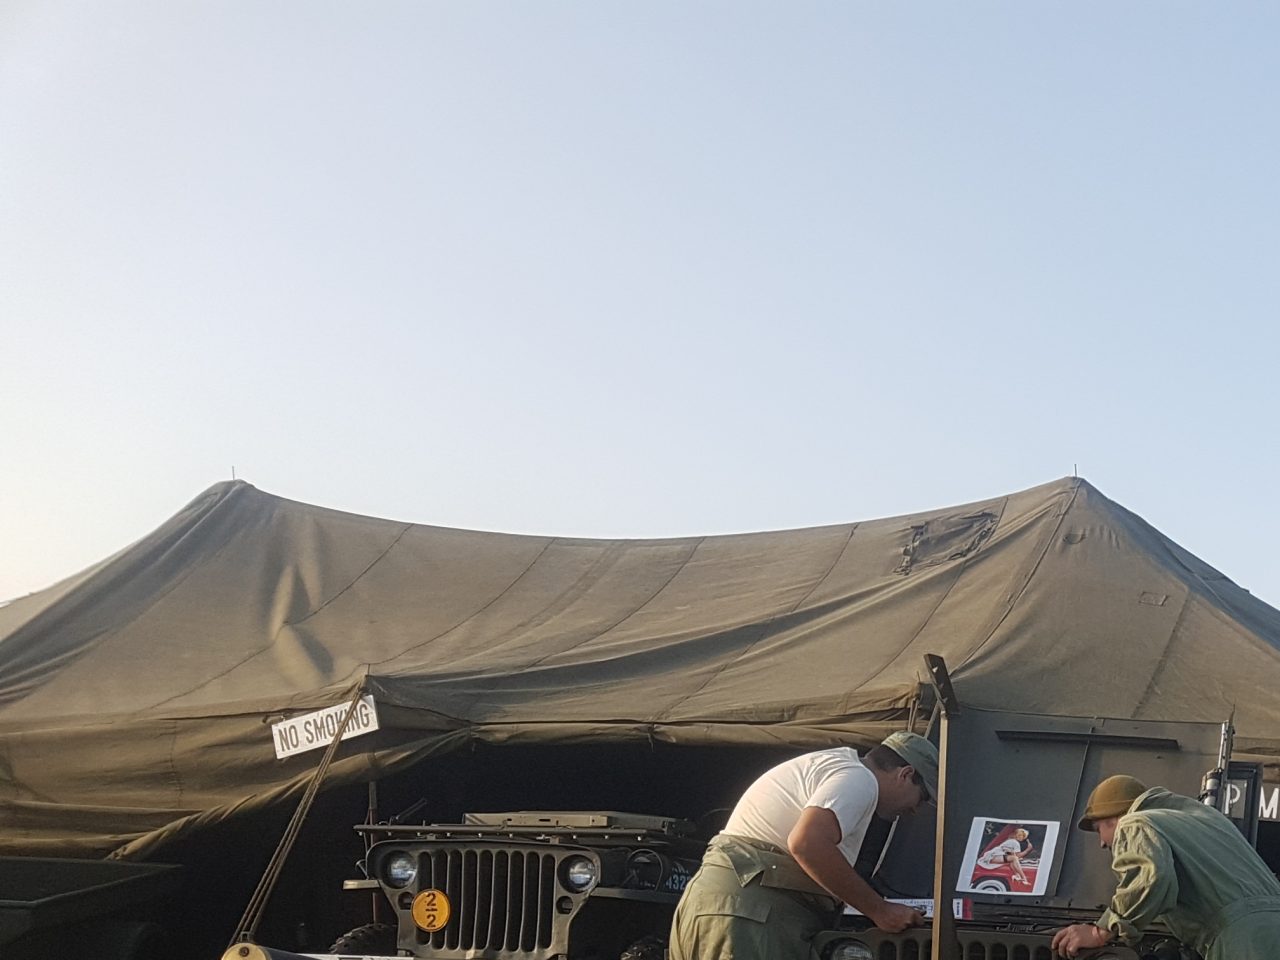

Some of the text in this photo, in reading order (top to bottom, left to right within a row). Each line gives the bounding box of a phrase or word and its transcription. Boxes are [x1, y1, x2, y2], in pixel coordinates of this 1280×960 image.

[278, 724, 300, 752] NO
[426, 892, 437, 907] 2
[426, 914, 437, 928] 2
